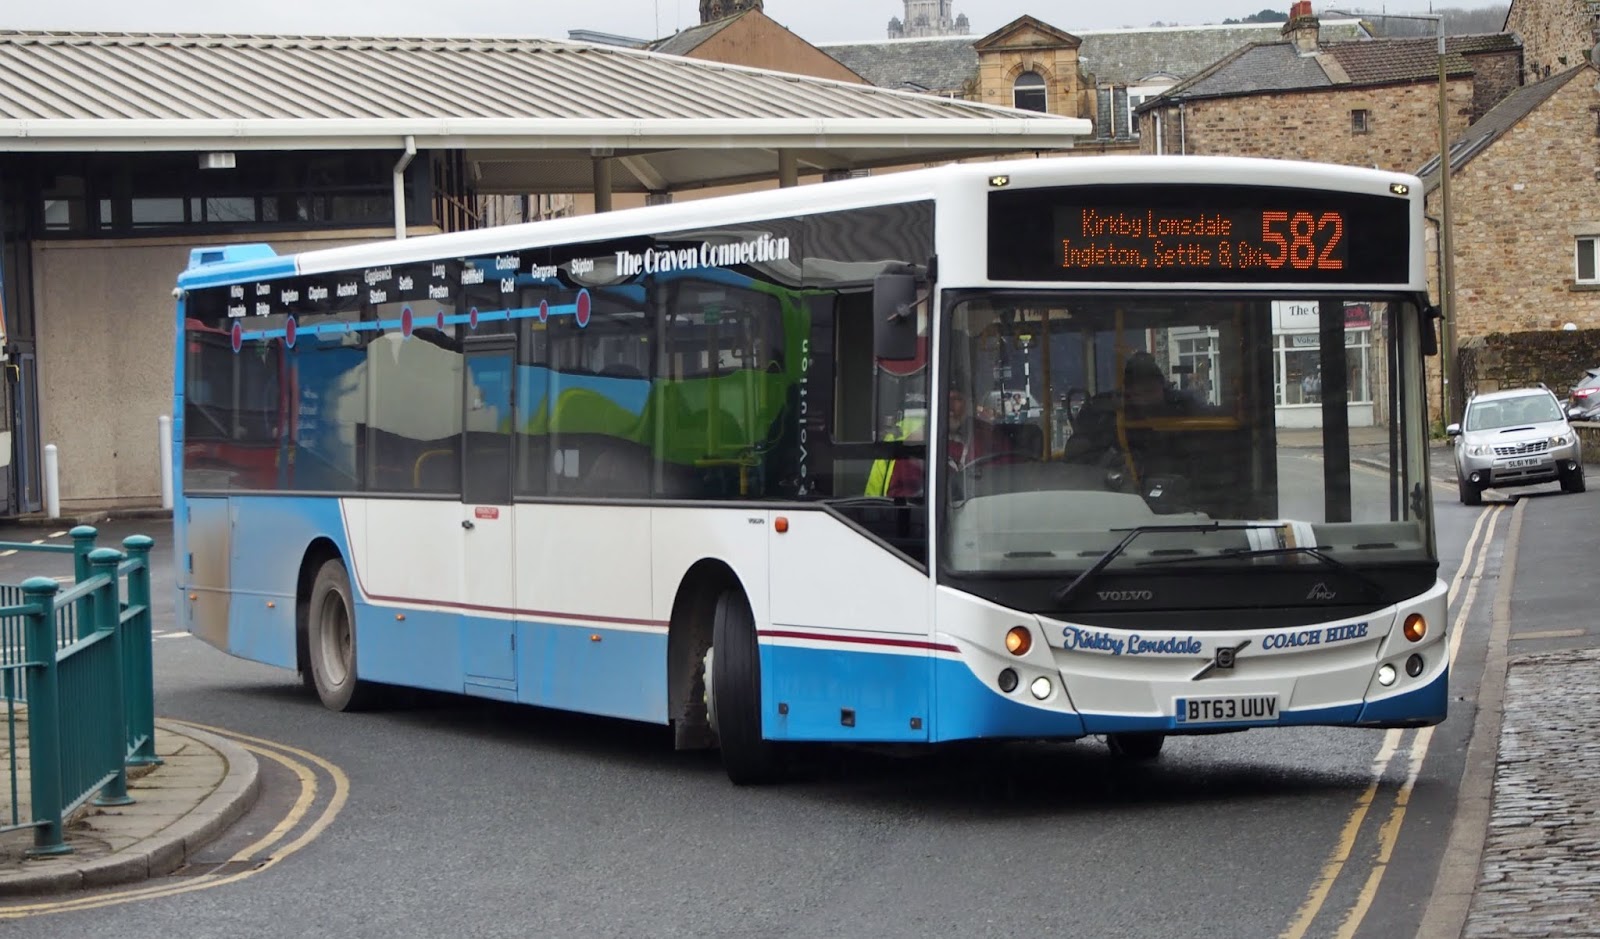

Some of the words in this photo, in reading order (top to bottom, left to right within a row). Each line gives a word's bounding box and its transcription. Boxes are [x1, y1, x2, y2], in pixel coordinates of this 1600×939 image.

[1082, 209, 1142, 237] Kirkby
[1148, 210, 1232, 237] Lonsdale
[1262, 211, 1343, 269] 582
[495, 254, 520, 270] Coniston
[615, 251, 643, 276] The
[644, 247, 697, 274] Craven
[700, 233, 790, 269] Connection
[1062, 239, 1148, 268] Ingleton,
[1154, 240, 1212, 268] Settle
[1218, 240, 1232, 269] &
[431, 262, 446, 279] Long
[531, 262, 558, 282] Gargrave
[571, 258, 594, 276] Skipton
[399, 275, 414, 291] Settle
[428, 284, 449, 299] Preston
[500, 277, 515, 293] Cold
[369, 289, 387, 304] Station
[1289, 304, 1309, 316] The
[1096, 590, 1153, 601] VOLVO
[1062, 625, 1124, 656] Kirkby
[1126, 634, 1202, 655] Lonsdale
[1262, 629, 1322, 650] COACH
[1325, 622, 1369, 643] HIRE
[1188, 699, 1236, 720] BT63
[1241, 697, 1276, 718] UUV
